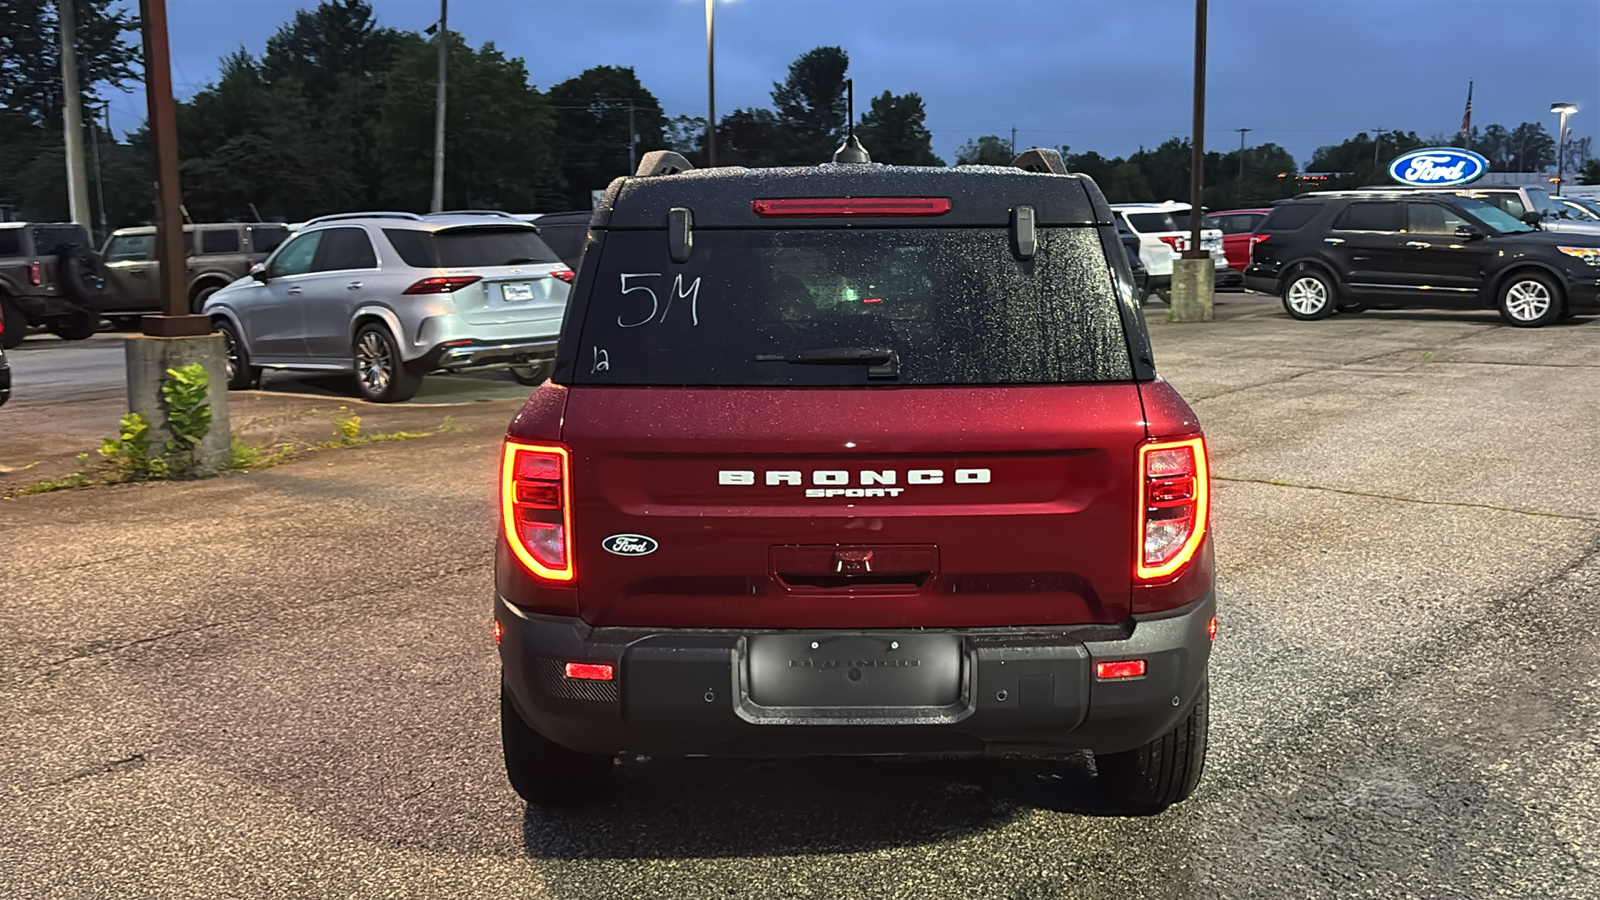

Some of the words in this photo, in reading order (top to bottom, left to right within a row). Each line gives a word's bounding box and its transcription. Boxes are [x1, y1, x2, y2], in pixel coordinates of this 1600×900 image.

[1405, 156, 1466, 181] Ford
[617, 273, 701, 328] 5M
[718, 469, 991, 486] BRONCO
[805, 487, 905, 498] SPORT
[612, 537, 648, 552] Ford
